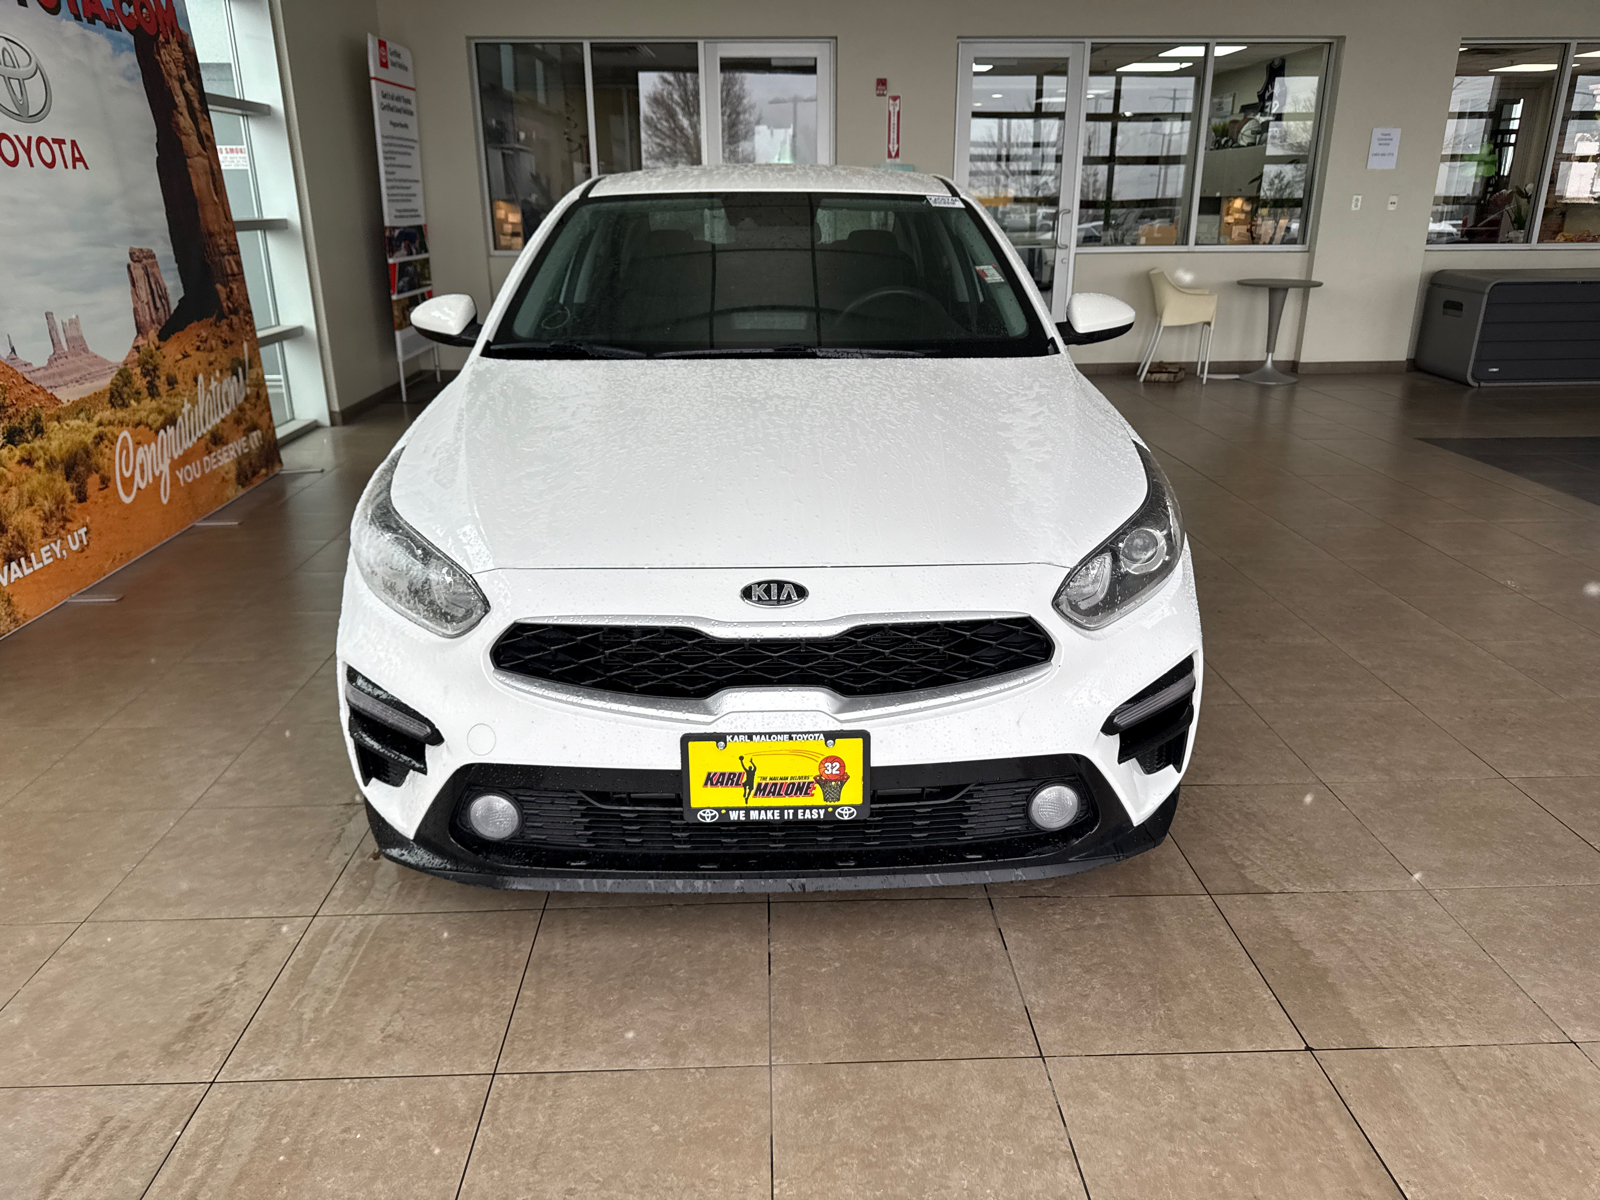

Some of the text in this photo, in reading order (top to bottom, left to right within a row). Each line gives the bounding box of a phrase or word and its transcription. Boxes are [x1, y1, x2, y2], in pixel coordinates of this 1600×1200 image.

[0, 132, 89, 170] OYOTA
[175, 429, 263, 487] YOU DESERVE IT!
[0, 526, 87, 587] VALLEY, UT
[751, 583, 798, 600] KIA
[726, 733, 825, 742] KARL MALONE TOYOTA
[824, 762, 840, 774] 32
[702, 771, 745, 788] KARL
[752, 780, 816, 798] MALONE
[729, 809, 825, 820] WE MAKE IT EASY
